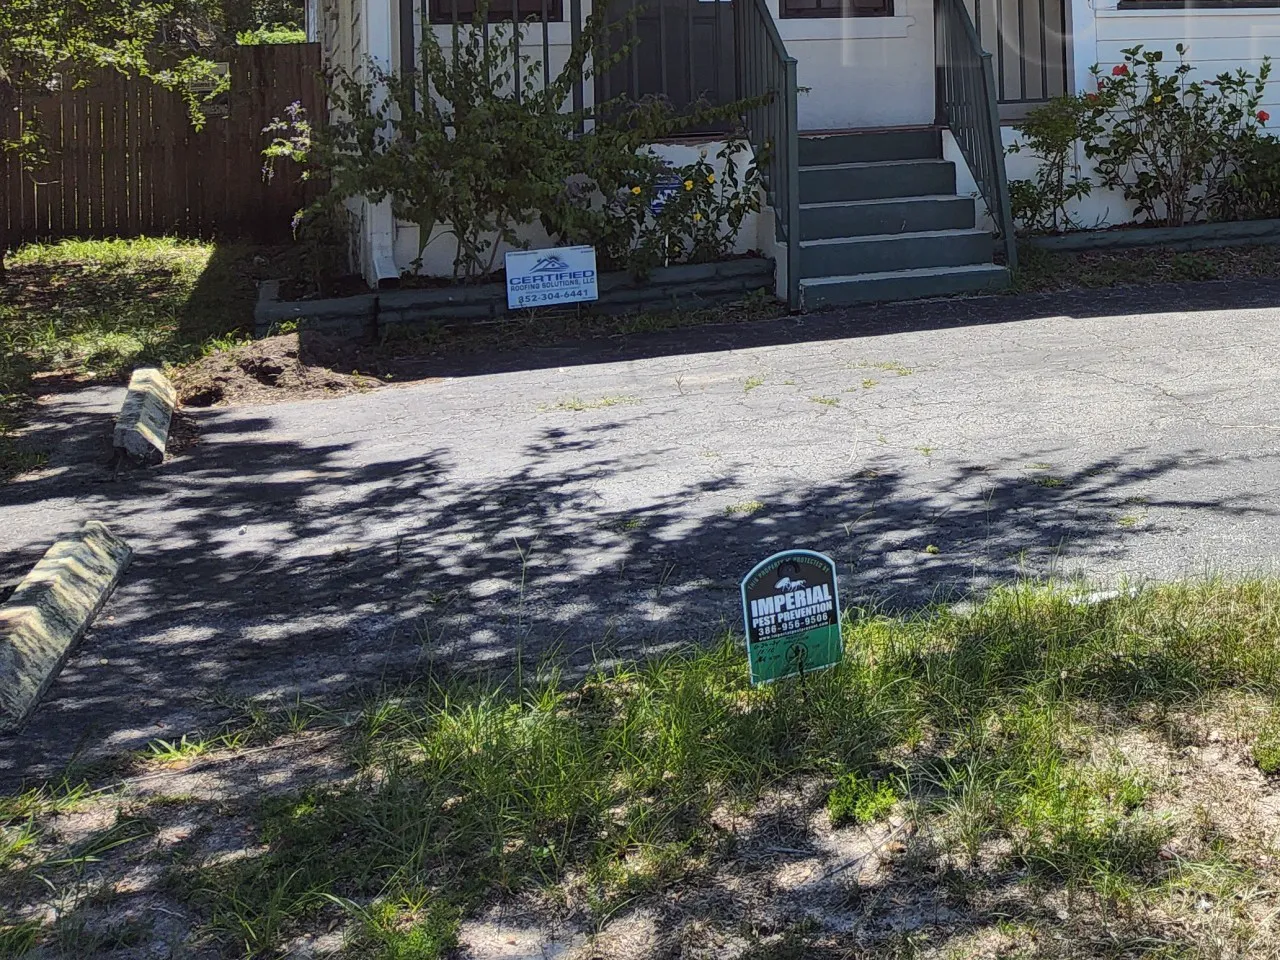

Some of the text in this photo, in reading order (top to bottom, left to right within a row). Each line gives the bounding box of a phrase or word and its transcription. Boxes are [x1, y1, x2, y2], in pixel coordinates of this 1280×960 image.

[509, 270, 594, 285] CERTIFIED
[510, 283, 540, 292] ROOFING
[582, 277, 595, 285] LLC
[750, 583, 832, 618] IMPERIAL
[752, 600, 833, 629] PEST PREVENTION
[758, 612, 829, 637] 386-956-9506
